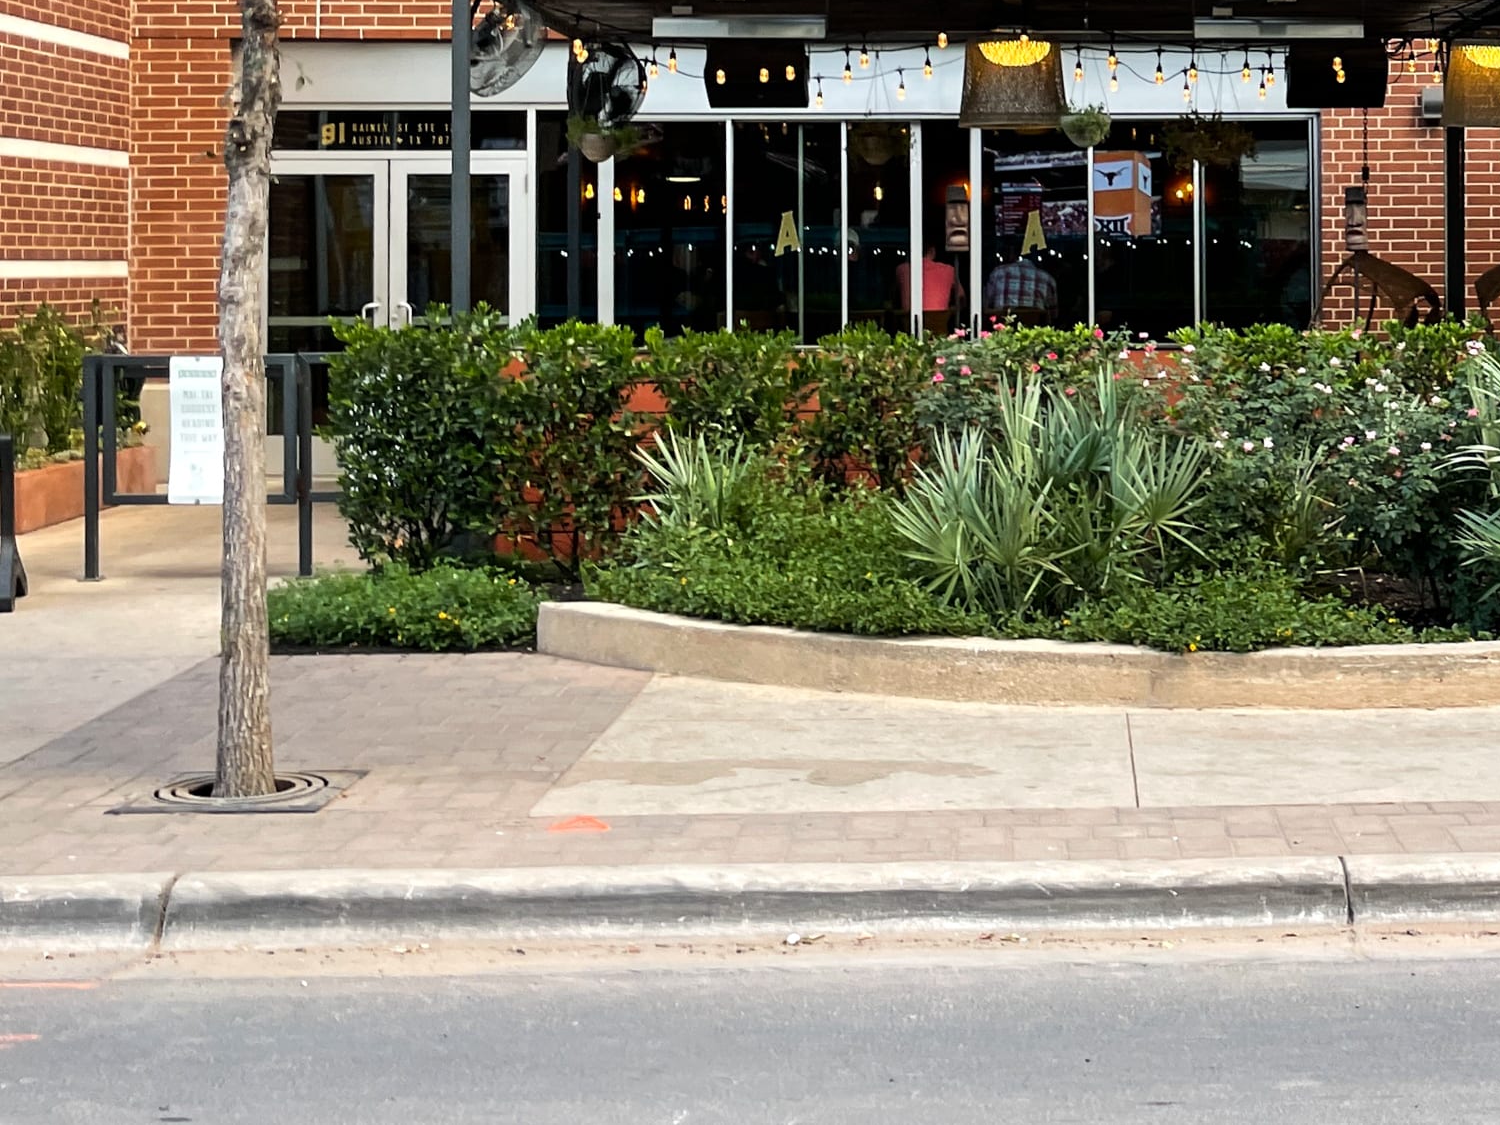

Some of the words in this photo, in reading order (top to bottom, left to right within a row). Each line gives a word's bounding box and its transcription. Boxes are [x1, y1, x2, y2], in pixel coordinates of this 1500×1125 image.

[352, 135, 391, 145] AUSTIN
[409, 135, 421, 145] TX
[774, 210, 801, 257] A
[1020, 209, 1047, 255] A
